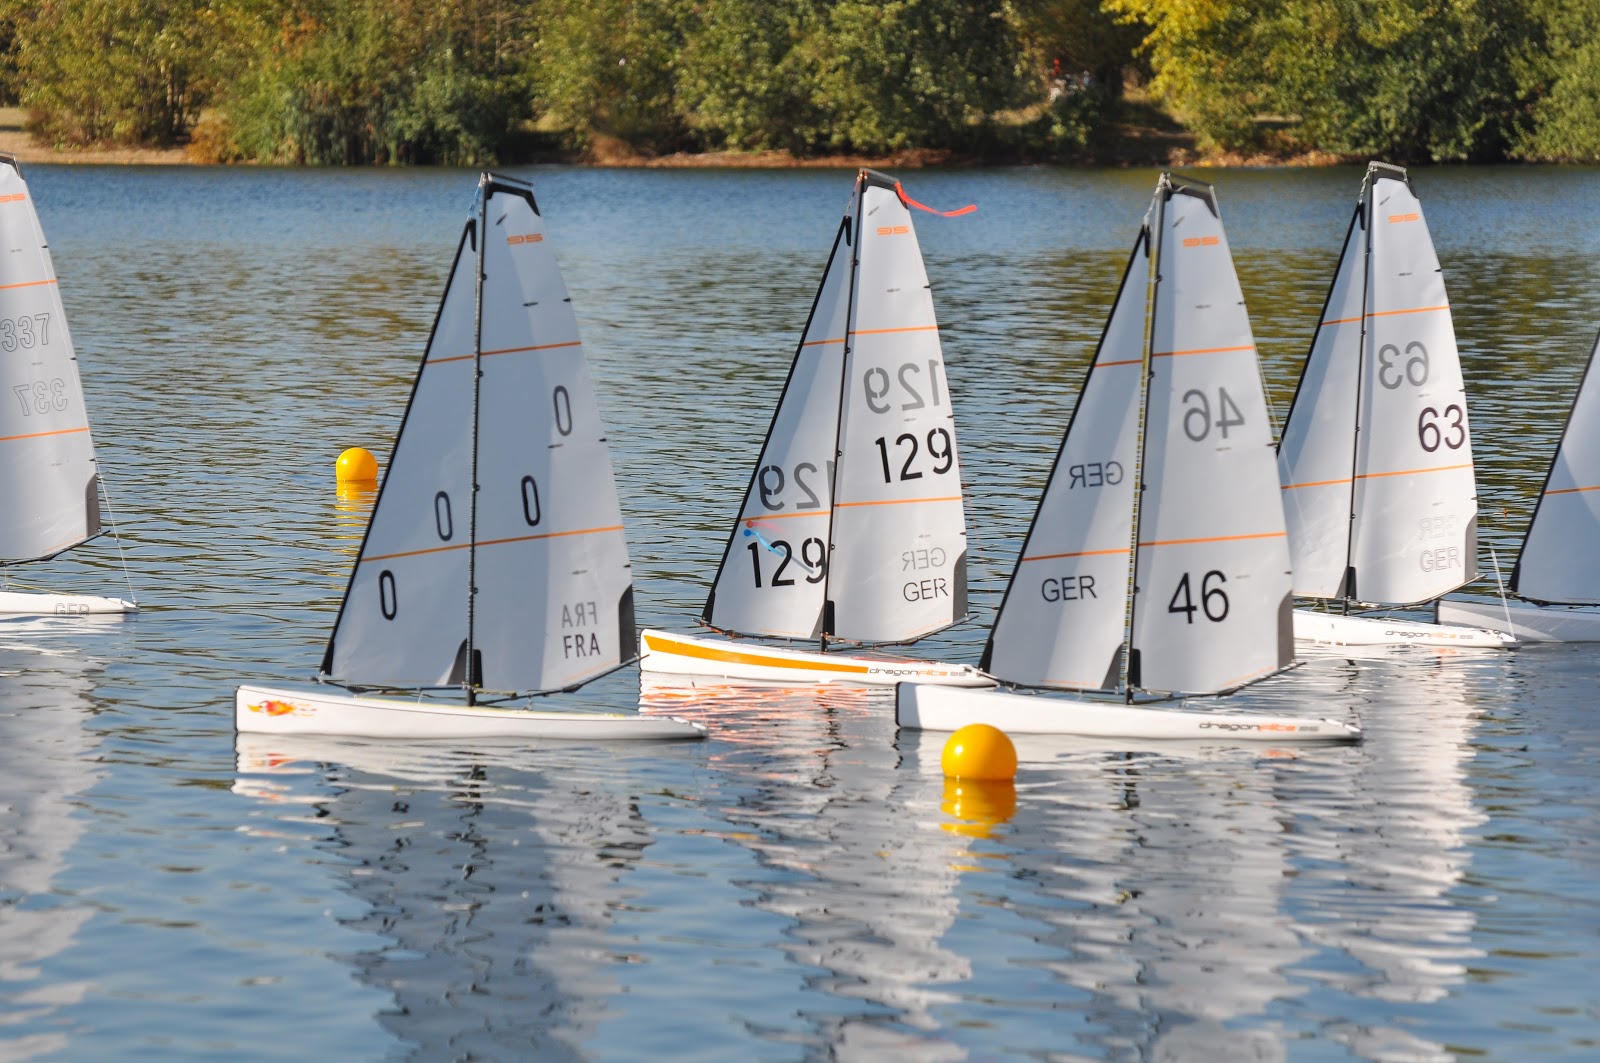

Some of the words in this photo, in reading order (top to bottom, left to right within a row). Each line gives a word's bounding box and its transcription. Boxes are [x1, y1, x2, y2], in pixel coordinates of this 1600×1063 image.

[877, 225, 909, 236] 95
[1387, 213, 1419, 223] 95
[506, 233, 543, 245] 95
[0, 312, 50, 353] 337
[1418, 404, 1466, 453] 63
[875, 427, 953, 483] 129
[521, 475, 541, 526] 0
[747, 537, 827, 588] 129
[1420, 546, 1462, 573] GER
[378, 569, 397, 621] 0
[903, 578, 949, 602] GER
[1041, 575, 1097, 602] GER
[1168, 569, 1229, 624] 46
[563, 632, 601, 659] FRA
[869, 667, 948, 677] dragonflite
